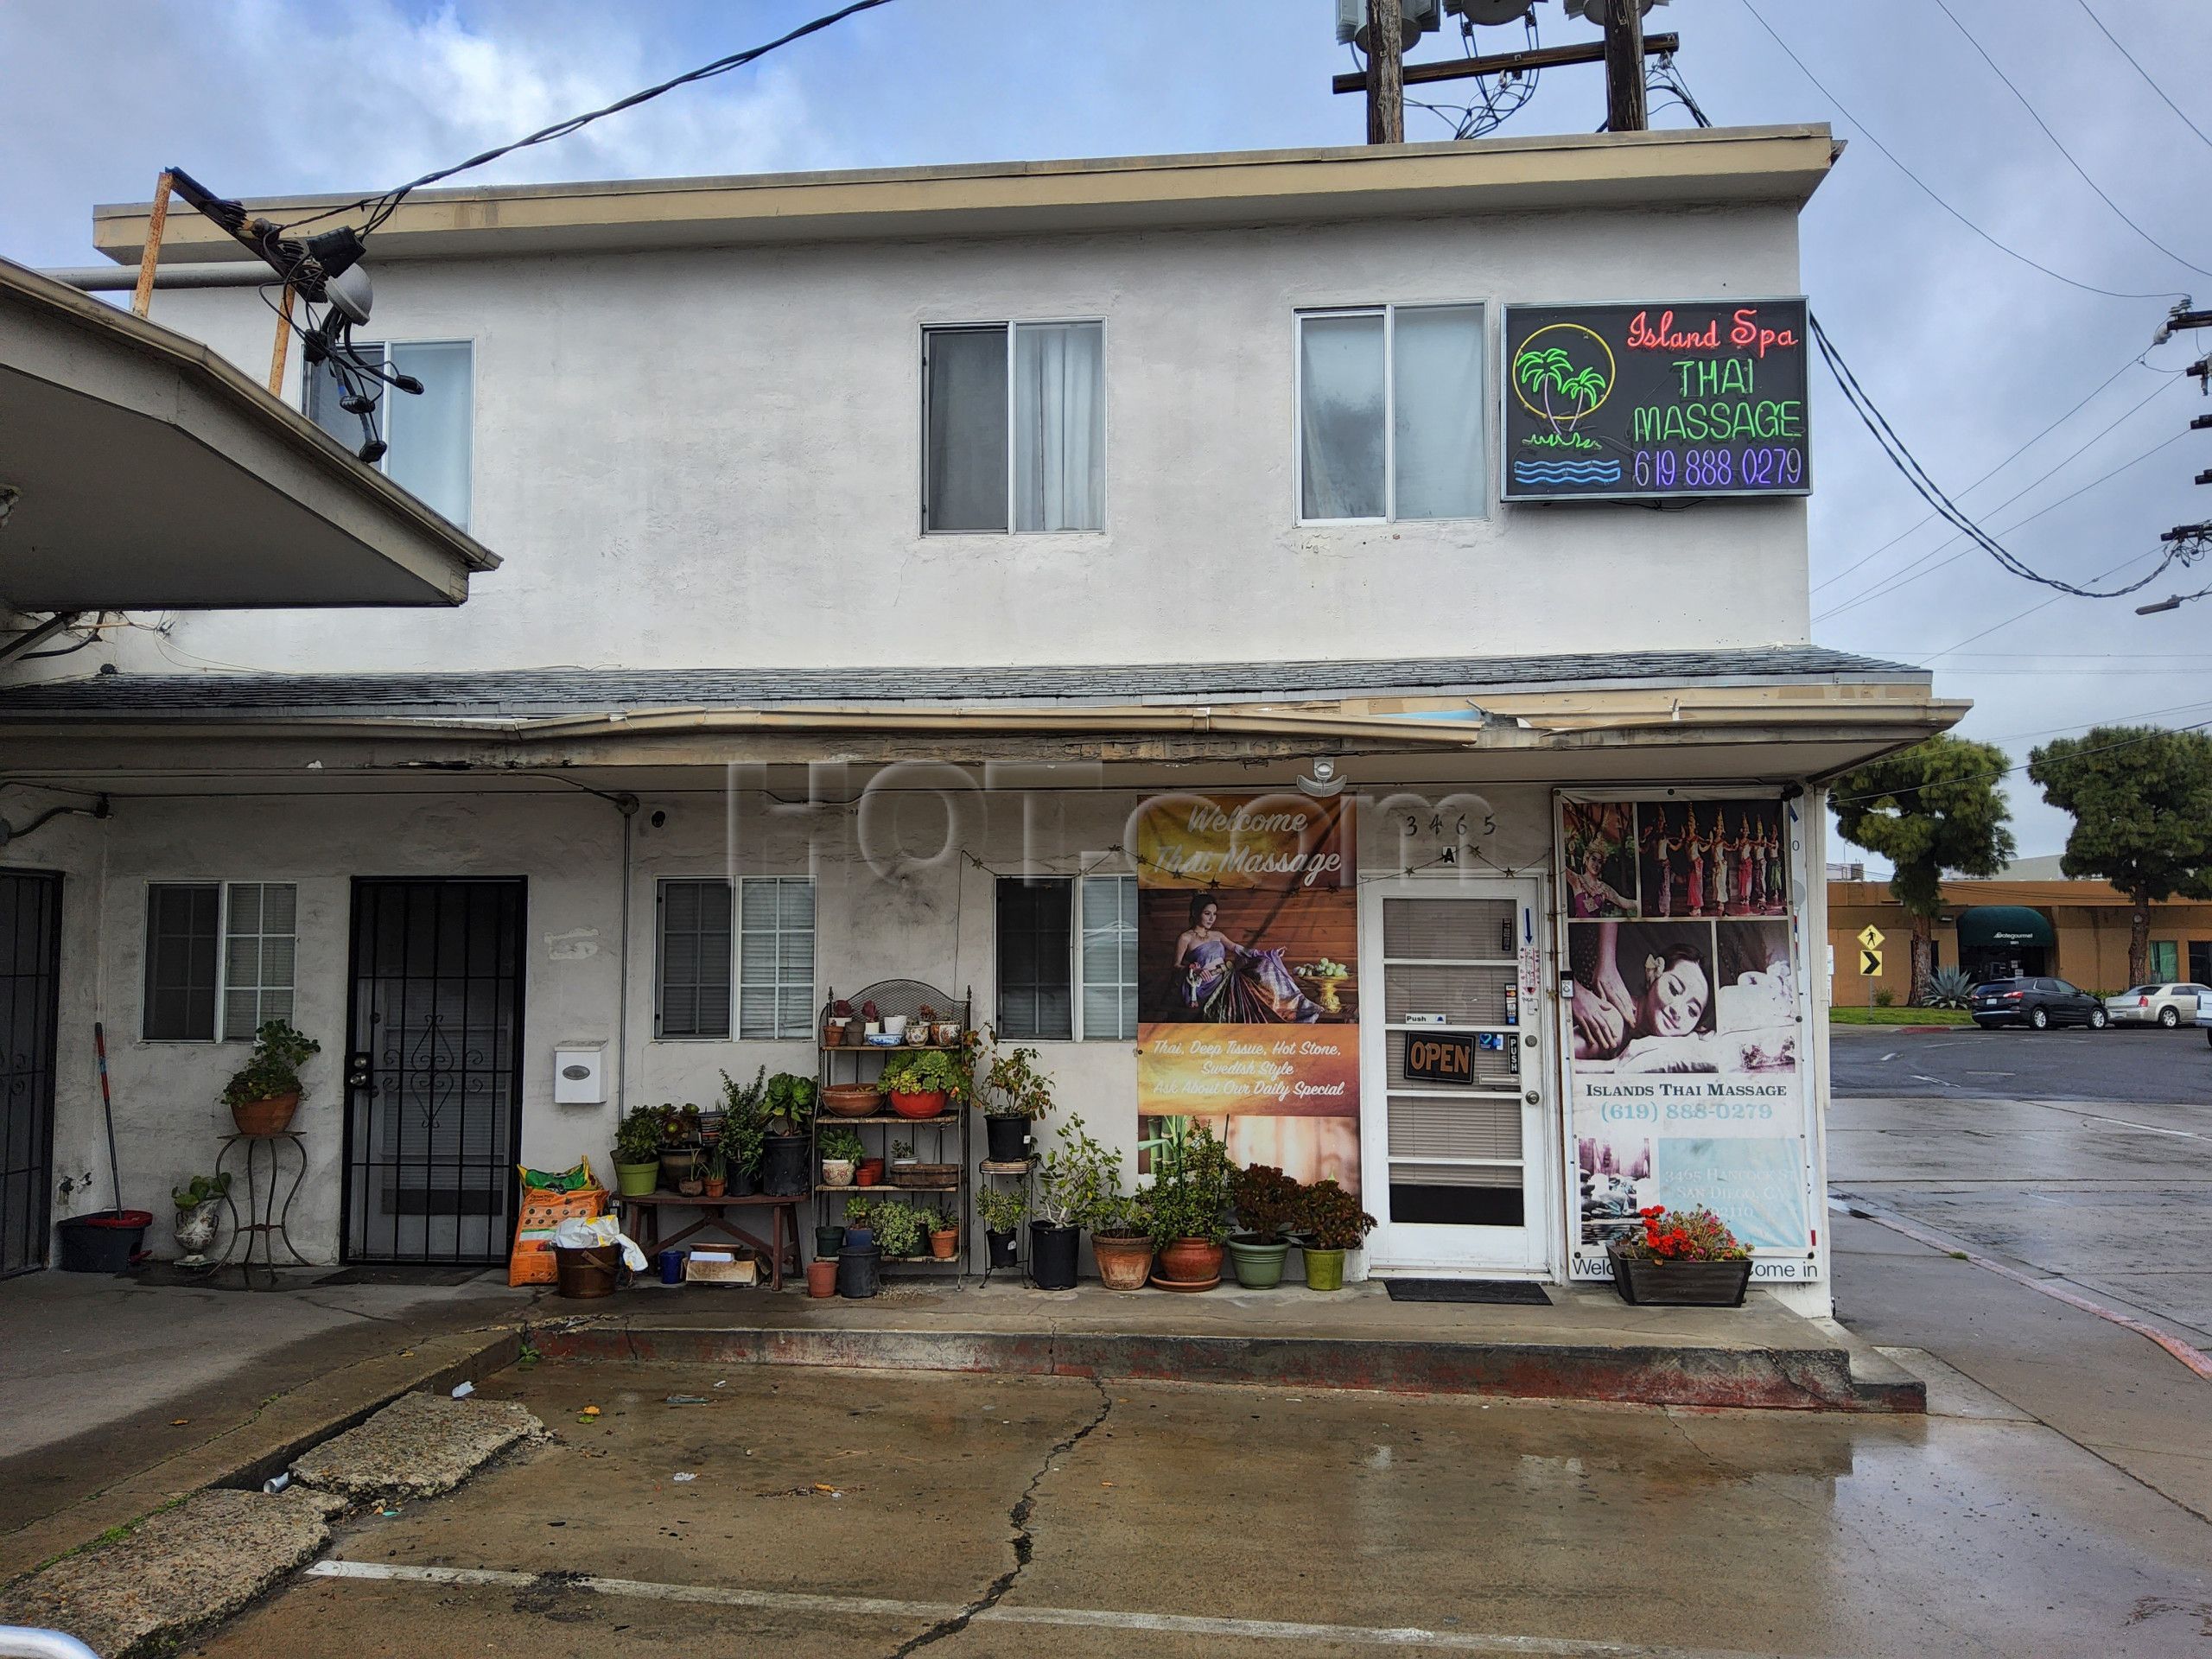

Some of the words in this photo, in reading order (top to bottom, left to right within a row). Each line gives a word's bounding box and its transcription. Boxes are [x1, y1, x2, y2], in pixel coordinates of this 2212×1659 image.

[1627, 310, 1720, 347] Island
[1731, 309, 1799, 359] Spa
[1672, 359, 1753, 397] THAI
[1634, 401, 1802, 442] MASSAGE
[1635, 449, 1675, 486] 619
[1686, 449, 1732, 486] 888
[1742, 448, 1802, 485] 0279
[1187, 804, 1308, 833] Welcome
[1405, 813, 1497, 836] 3465
[1443, 846, 1456, 863] A
[1218, 845, 1341, 887] Massage
[1154, 1040, 1184, 1056] Thai,
[1190, 1040, 1223, 1058] Deep
[1226, 1040, 1267, 1056] Tissue,
[1272, 1040, 1296, 1055] Hot
[1410, 1040, 1470, 1074] OPEN
[1201, 1061, 1255, 1076] Swedish
[1258, 1061, 1294, 1080] Style
[1154, 1081, 1178, 1094] Ask
[1181, 1081, 1219, 1094] About
[1223, 1081, 1251, 1094] Our
[1254, 1081, 1291, 1102] Daily
[1293, 1081, 1344, 1098] Special
[1586, 1084, 1654, 1096] ISLANDS
[1660, 1084, 1700, 1096] THAI
[1707, 1084, 1787, 1096] MASSAGE
[1601, 1101, 1658, 1123] (619)
[1666, 1103, 1772, 1120] 888-0279
[1665, 1168, 1701, 1182] 3465
[1572, 1258, 1614, 1275] Welc
[1750, 1264, 1795, 1277] ome
[1802, 1261, 1818, 1277] in
